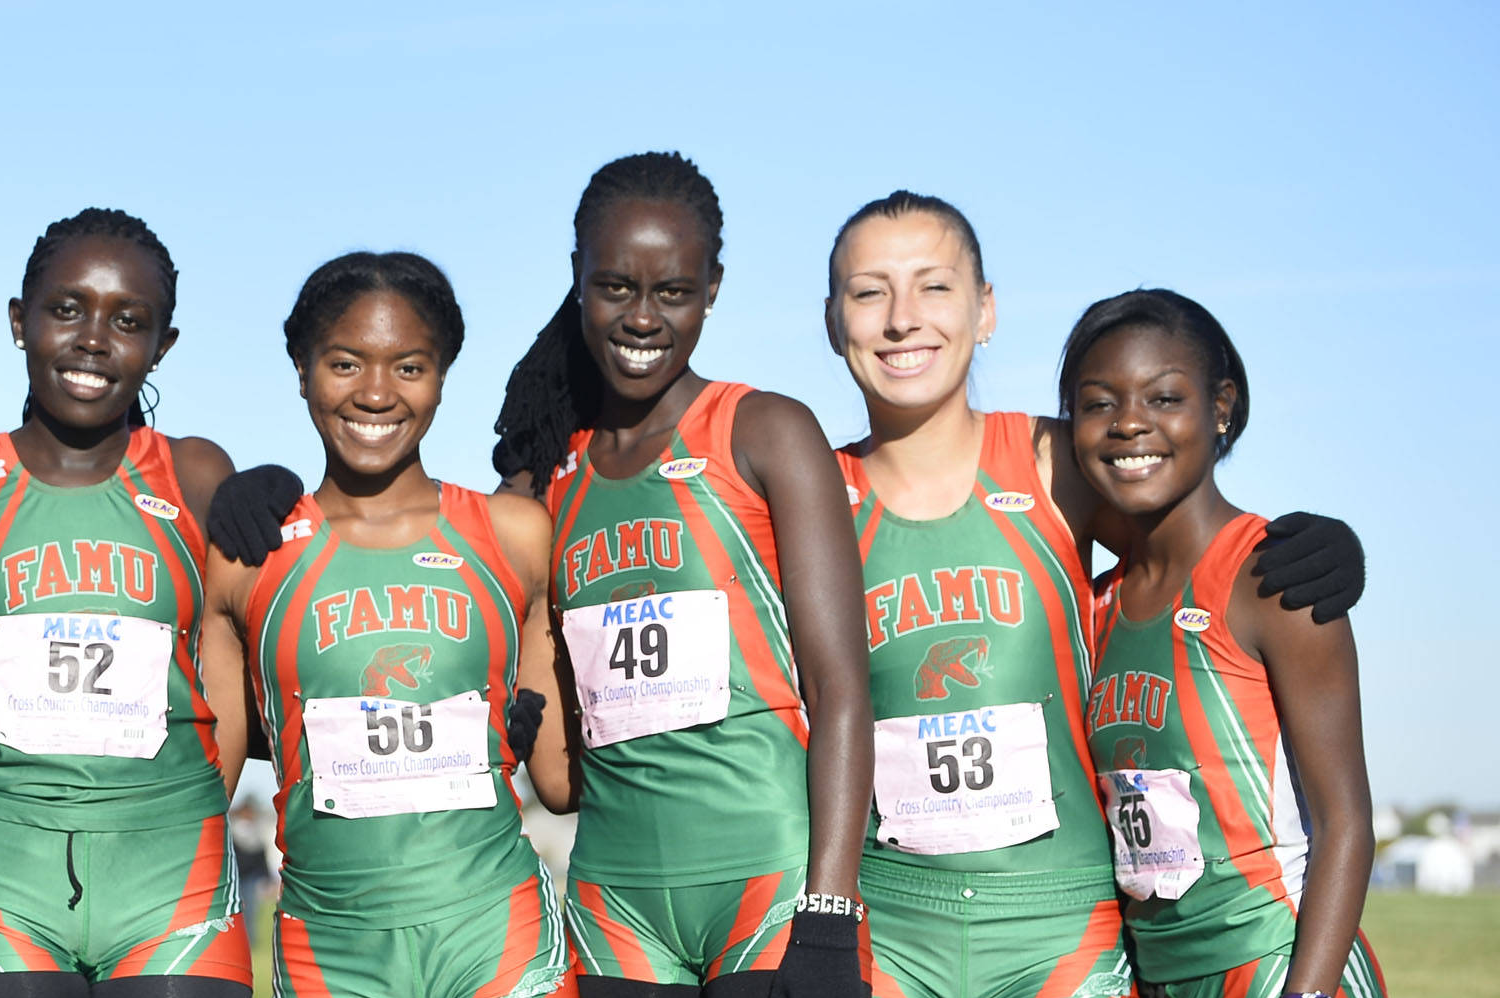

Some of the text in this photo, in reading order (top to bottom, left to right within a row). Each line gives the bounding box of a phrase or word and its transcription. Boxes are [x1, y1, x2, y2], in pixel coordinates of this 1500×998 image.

[2, 539, 158, 613] FAMU
[563, 517, 684, 600] FAMU
[43, 616, 122, 641] MEAC
[312, 584, 472, 654] FAMU
[602, 596, 674, 627] MEAC
[864, 565, 1024, 653] FAMU
[48, 641, 114, 695] 52
[609, 623, 668, 680] 49
[366, 703, 433, 756] 56
[918, 709, 997, 739] MEAC
[1086, 671, 1173, 742] FAMU
[332, 760, 358, 776] Cross
[926, 736, 994, 794] 53
[1119, 793, 1151, 848] 55
